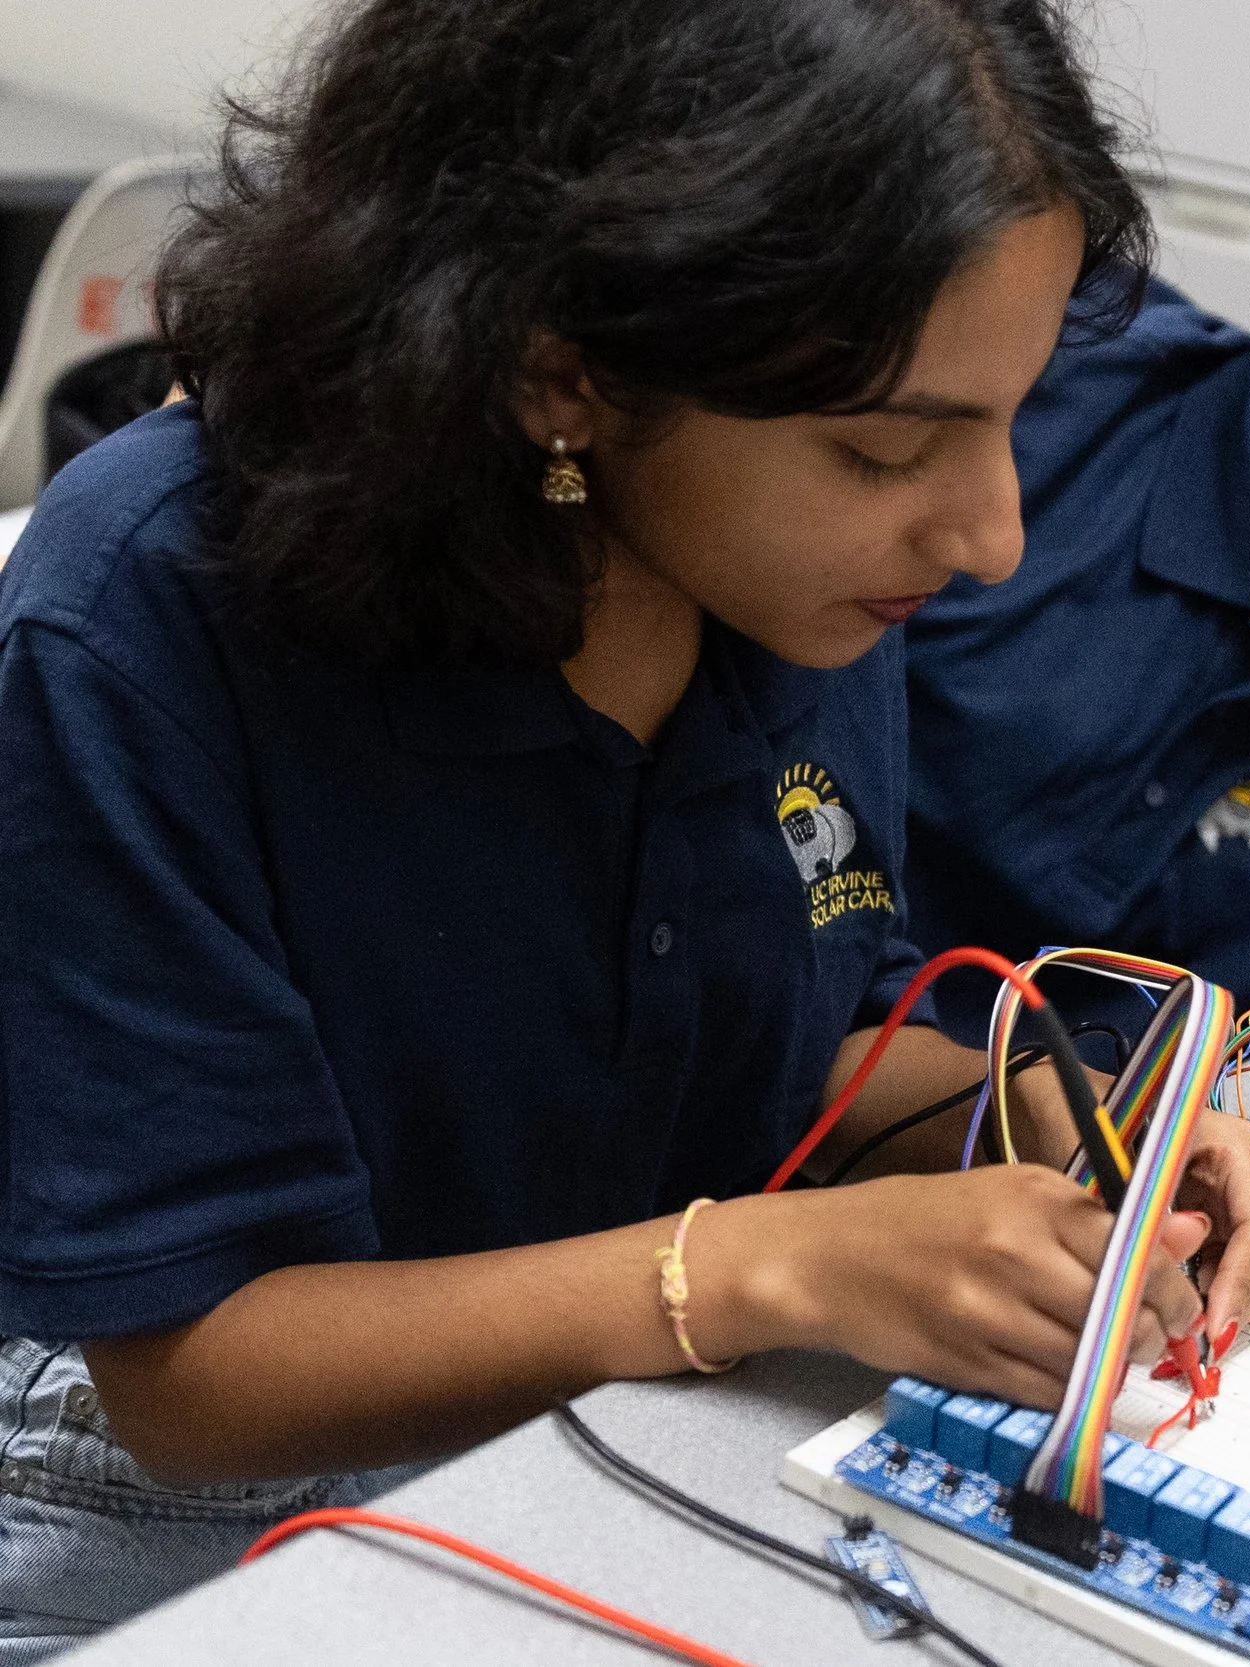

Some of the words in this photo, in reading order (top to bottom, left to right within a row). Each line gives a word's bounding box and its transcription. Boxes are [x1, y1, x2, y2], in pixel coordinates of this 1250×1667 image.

[811, 880, 827, 906] UC
[828, 871, 884, 896] IRVINE
[811, 894, 845, 929] SOLAR
